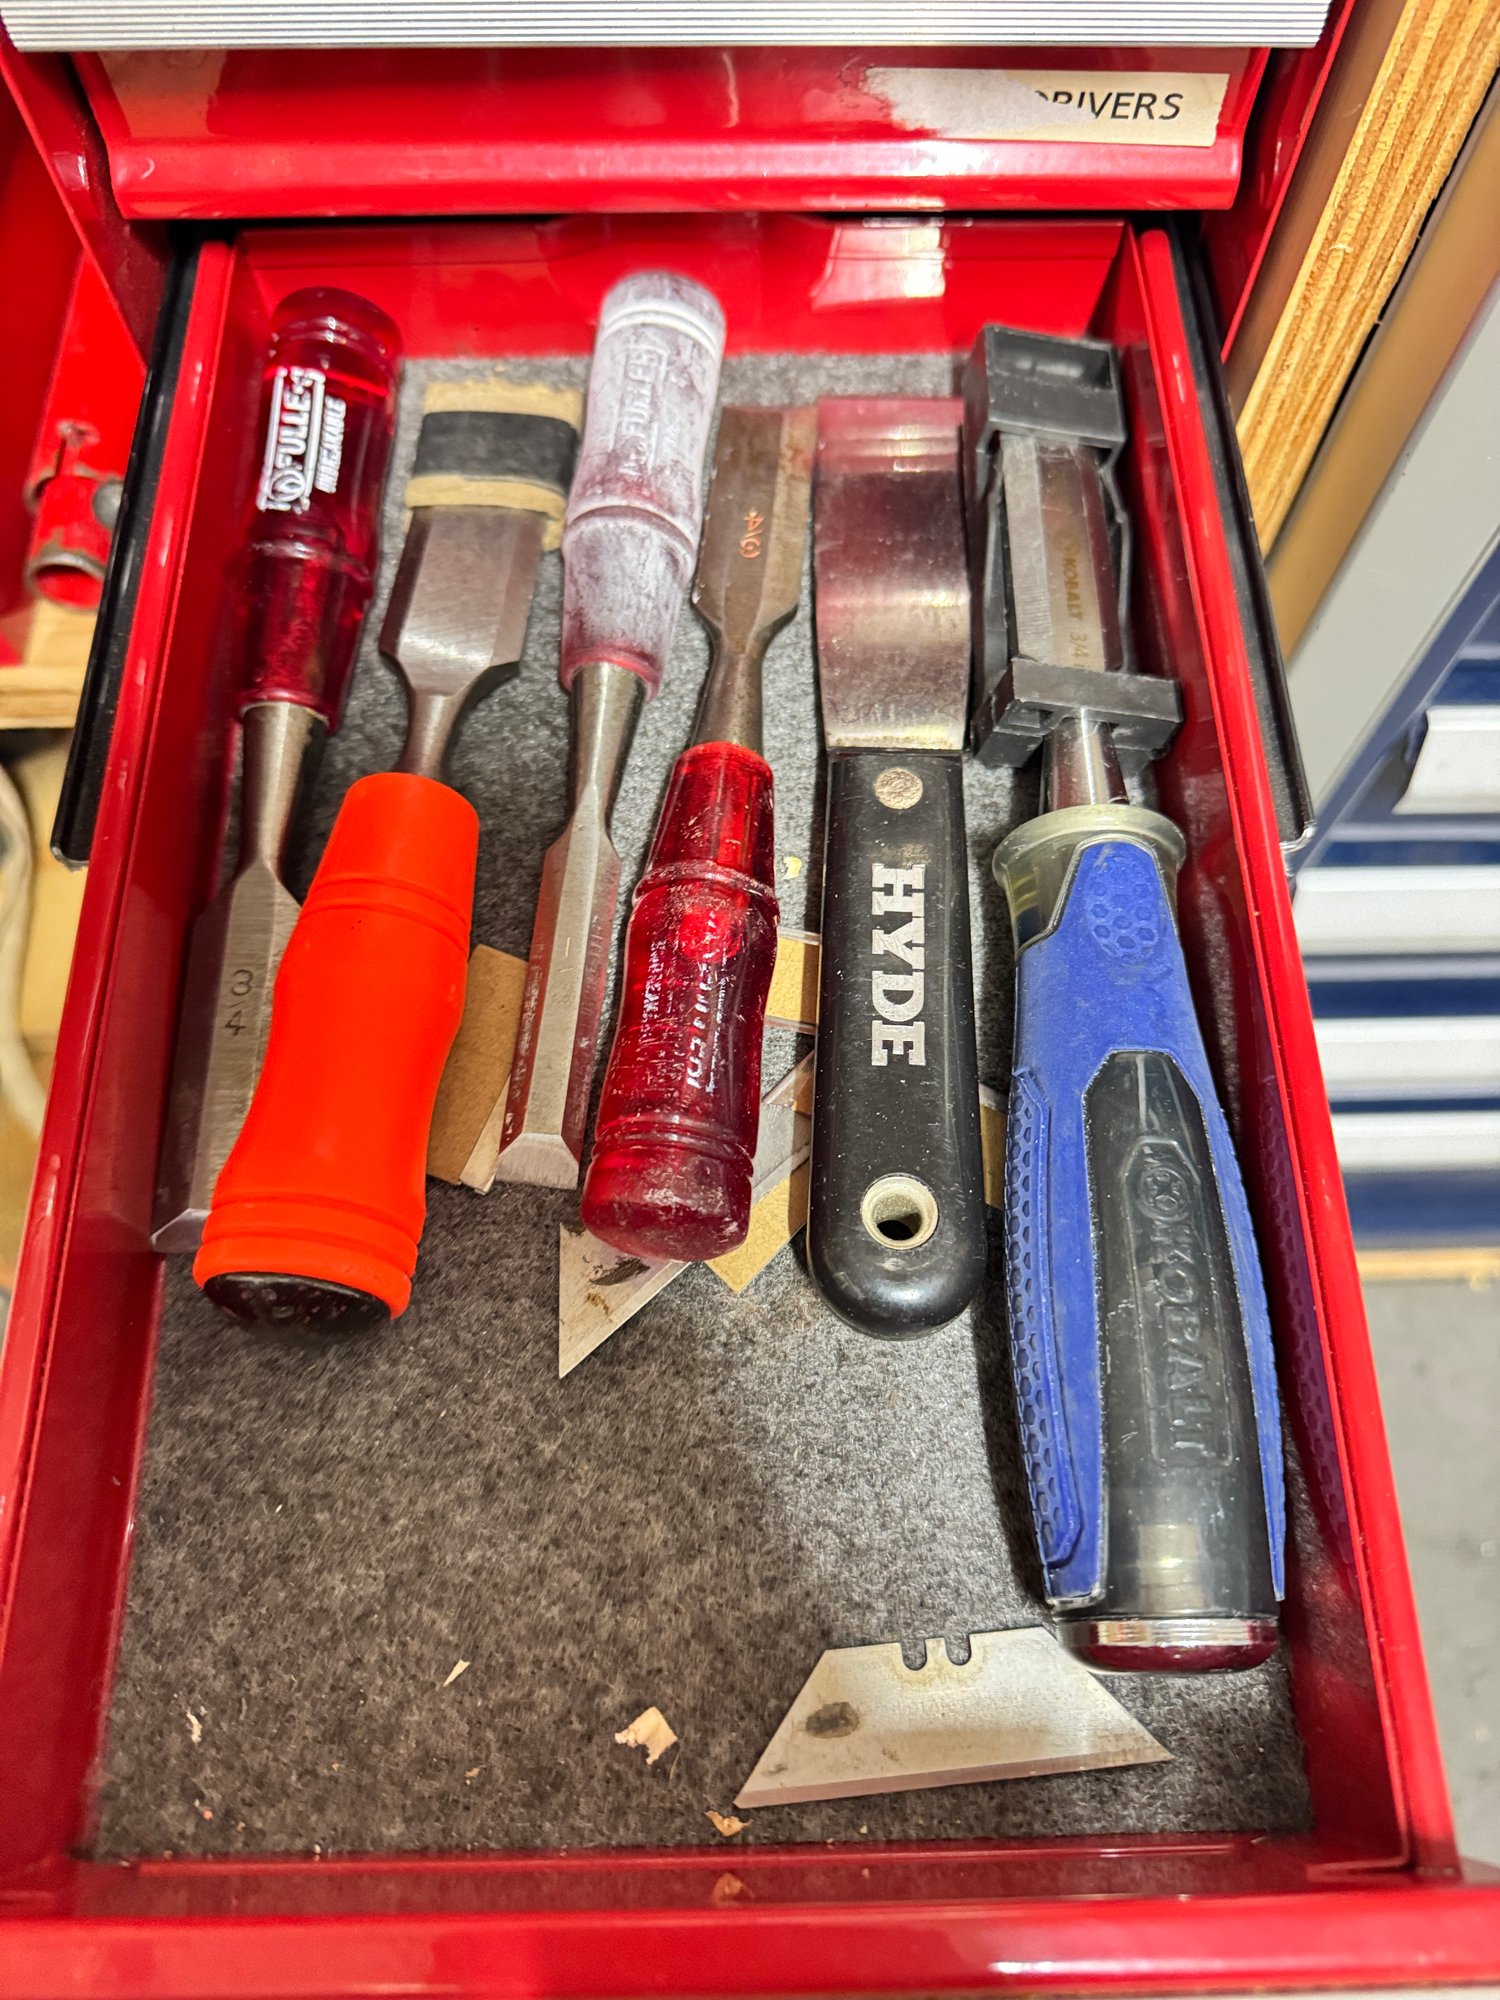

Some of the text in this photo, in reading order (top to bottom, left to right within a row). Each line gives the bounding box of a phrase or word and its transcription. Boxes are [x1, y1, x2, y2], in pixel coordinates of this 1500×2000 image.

[1033, 90, 1184, 120] IVERS
[1062, 557, 1084, 621] KOBALT
[872, 863, 926, 1066] HYDE
[1150, 1221, 1216, 1457] KOBALT
